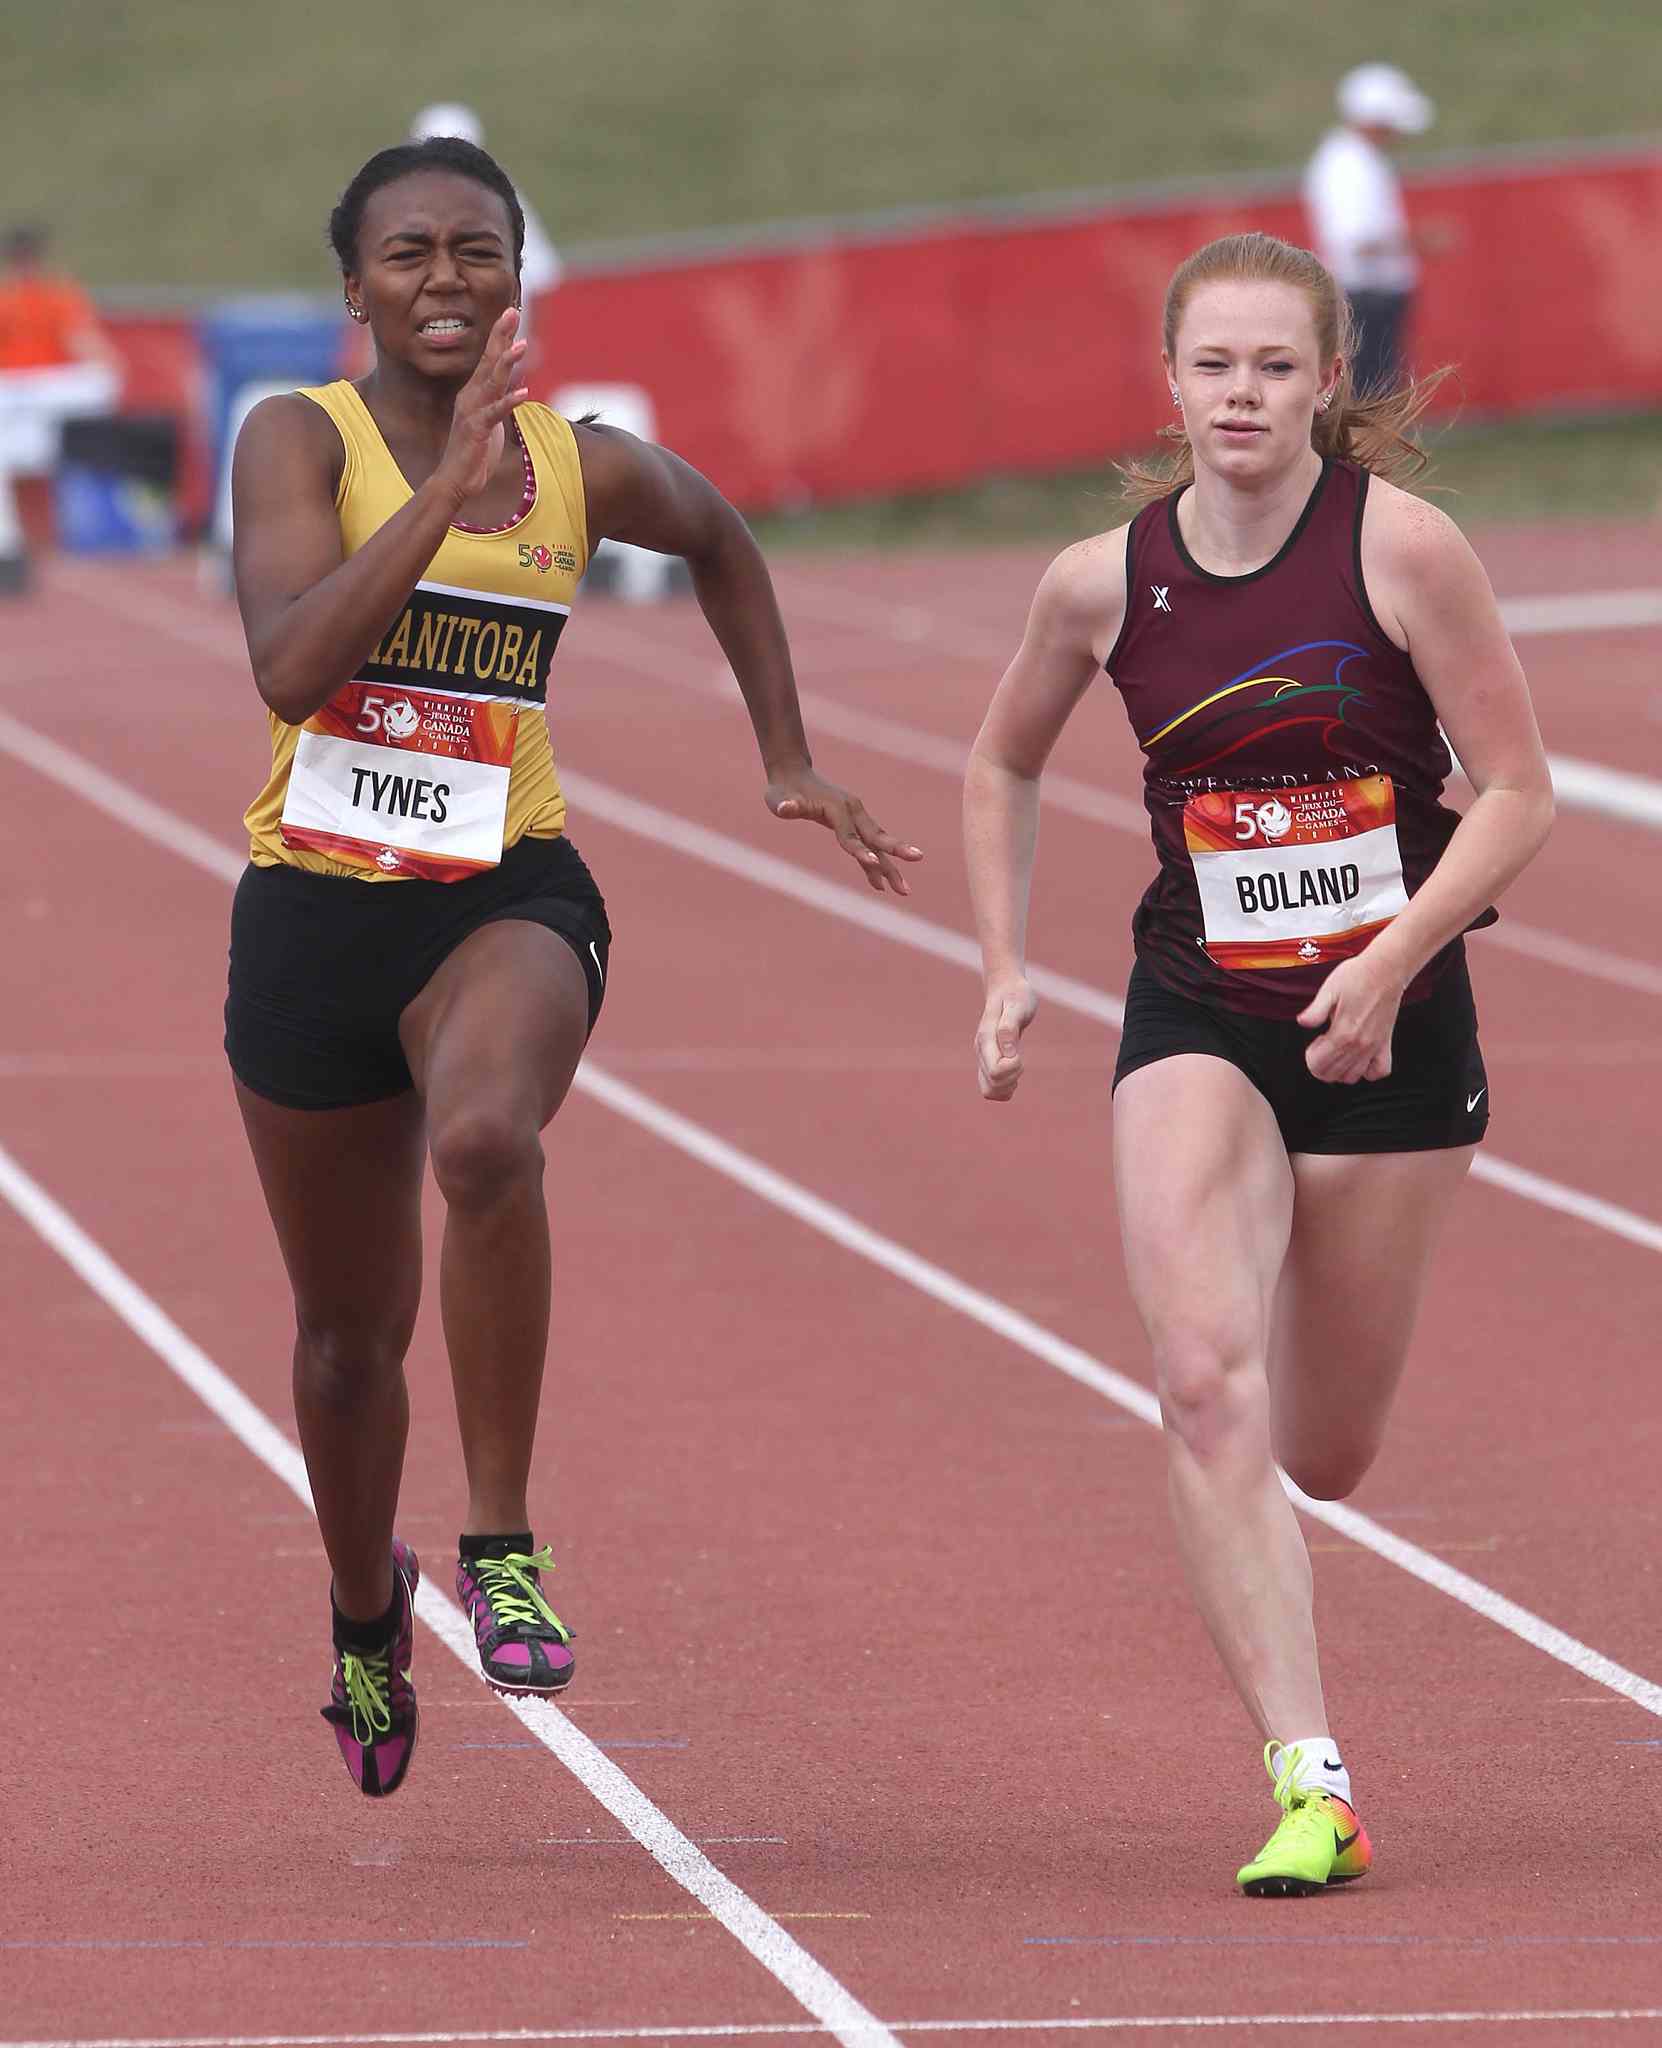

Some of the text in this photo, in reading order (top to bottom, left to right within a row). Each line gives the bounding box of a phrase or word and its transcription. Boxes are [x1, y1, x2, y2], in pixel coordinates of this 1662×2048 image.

[424, 701, 475, 716] WINNIPEG
[430, 711, 465, 724] JEUX DU
[423, 719, 470, 736] CANADA
[429, 731, 461, 743] GAMES
[351, 767, 450, 823] TYNES
[1290, 788, 1344, 804] WINNIPEG
[1301, 799, 1337, 812] JEUX DU
[1295, 807, 1347, 822] CANADA
[1305, 818, 1339, 830] GAMES
[1236, 863, 1360, 913] BOLAND
